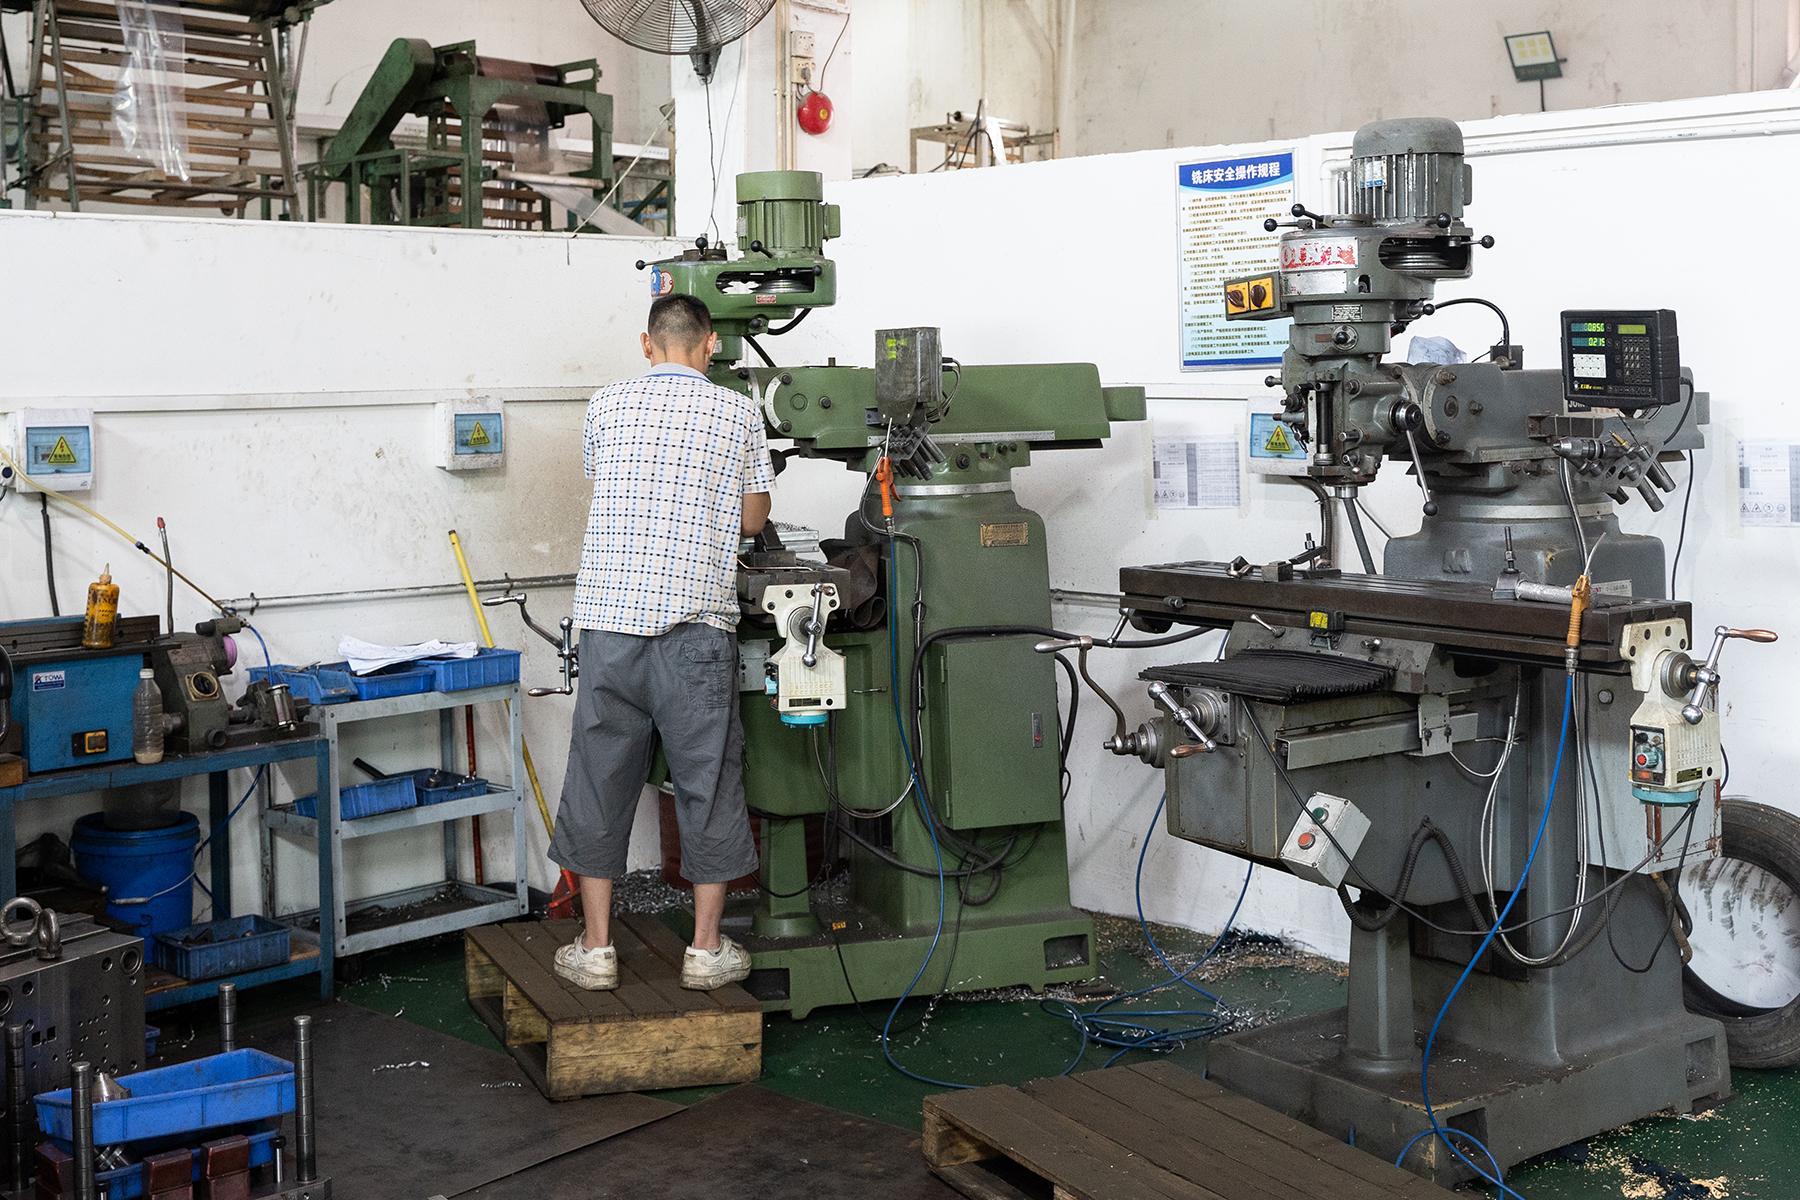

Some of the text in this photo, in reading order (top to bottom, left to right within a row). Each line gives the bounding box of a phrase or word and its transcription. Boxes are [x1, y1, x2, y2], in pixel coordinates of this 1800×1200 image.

[1191, 162, 1281, 184] 铣床安全操作规程
